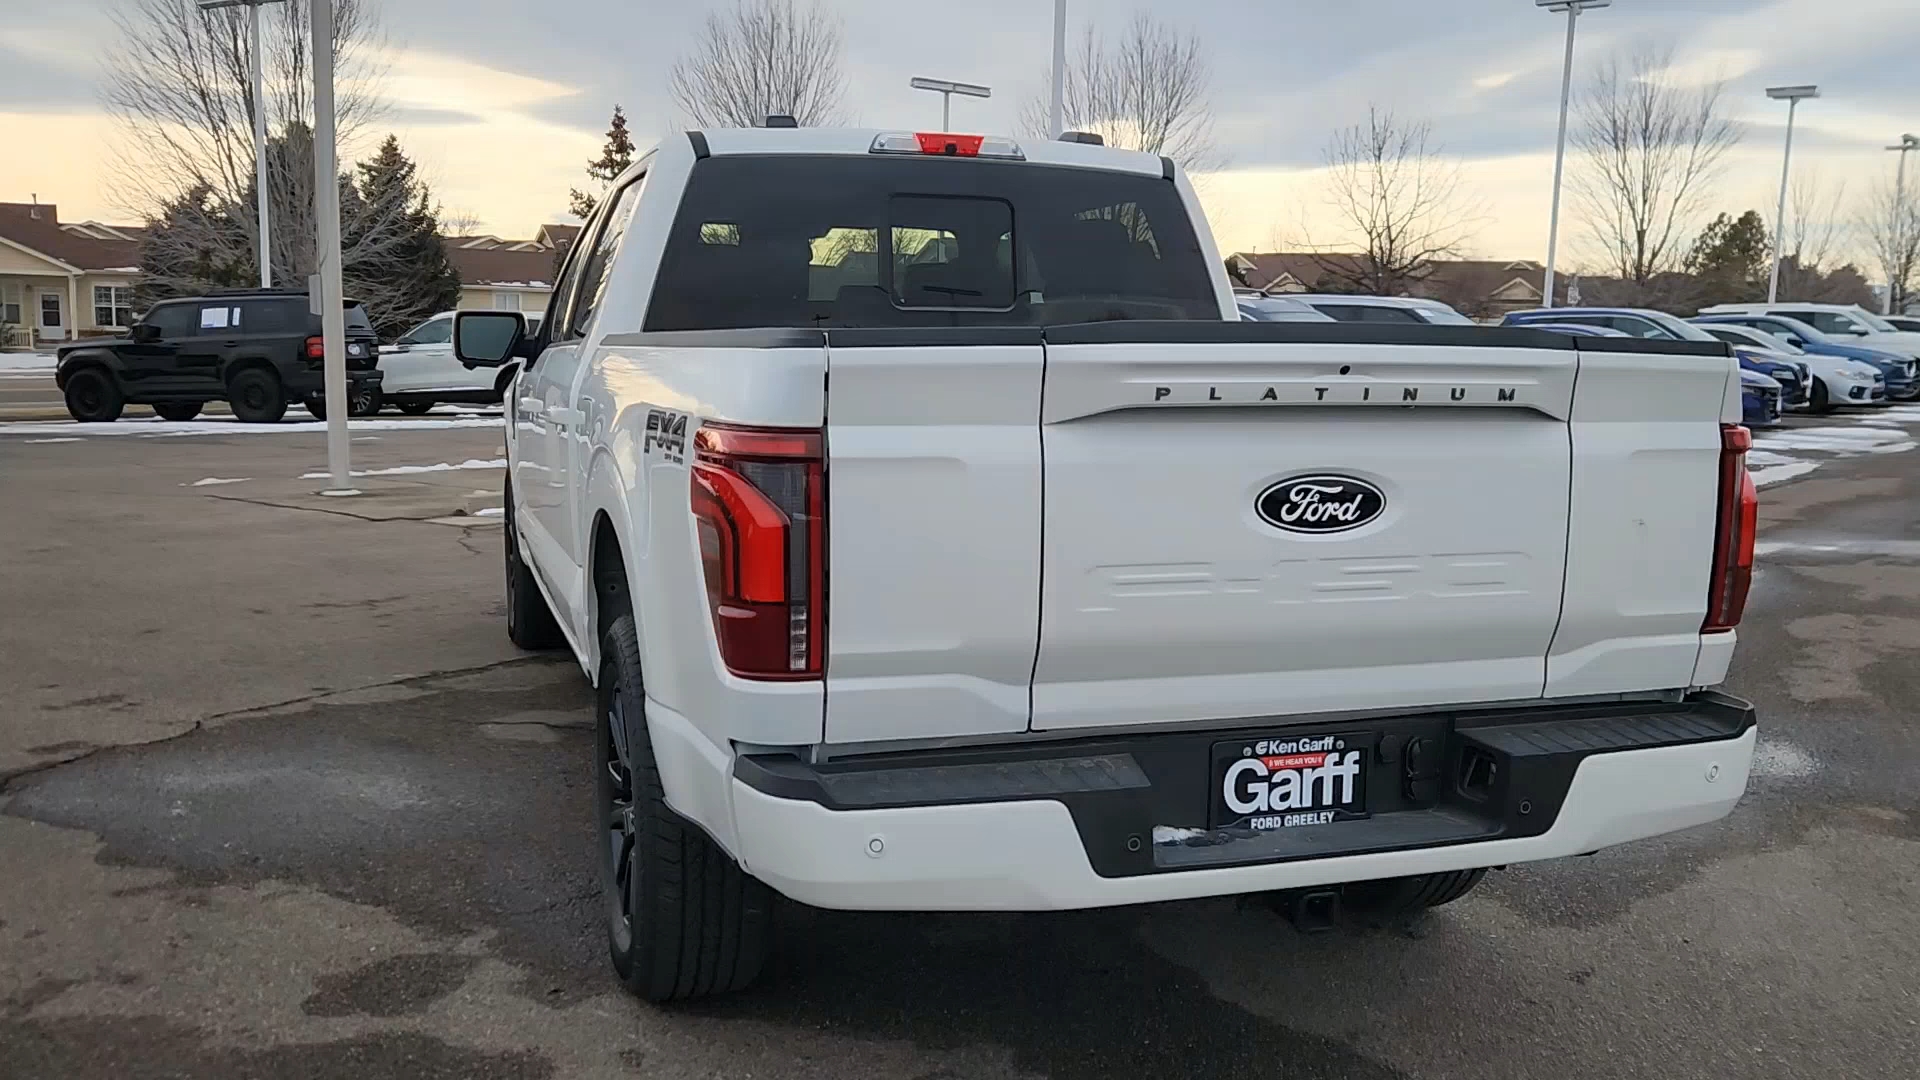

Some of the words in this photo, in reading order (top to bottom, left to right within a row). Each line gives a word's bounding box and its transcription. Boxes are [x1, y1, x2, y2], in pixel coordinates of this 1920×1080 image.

[1154, 386, 1516, 403] PLATINUM
[1280, 483, 1364, 522] Ford
[1268, 740, 1298, 755] Ken
[1298, 736, 1335, 753] Garff
[1273, 758, 1285, 767] WE
[1285, 757, 1304, 766] HEAR
[1304, 756, 1318, 765] YOU
[1223, 750, 1360, 815] Garff
[1250, 816, 1282, 831] FORD
[1283, 811, 1335, 828] GREELEY
